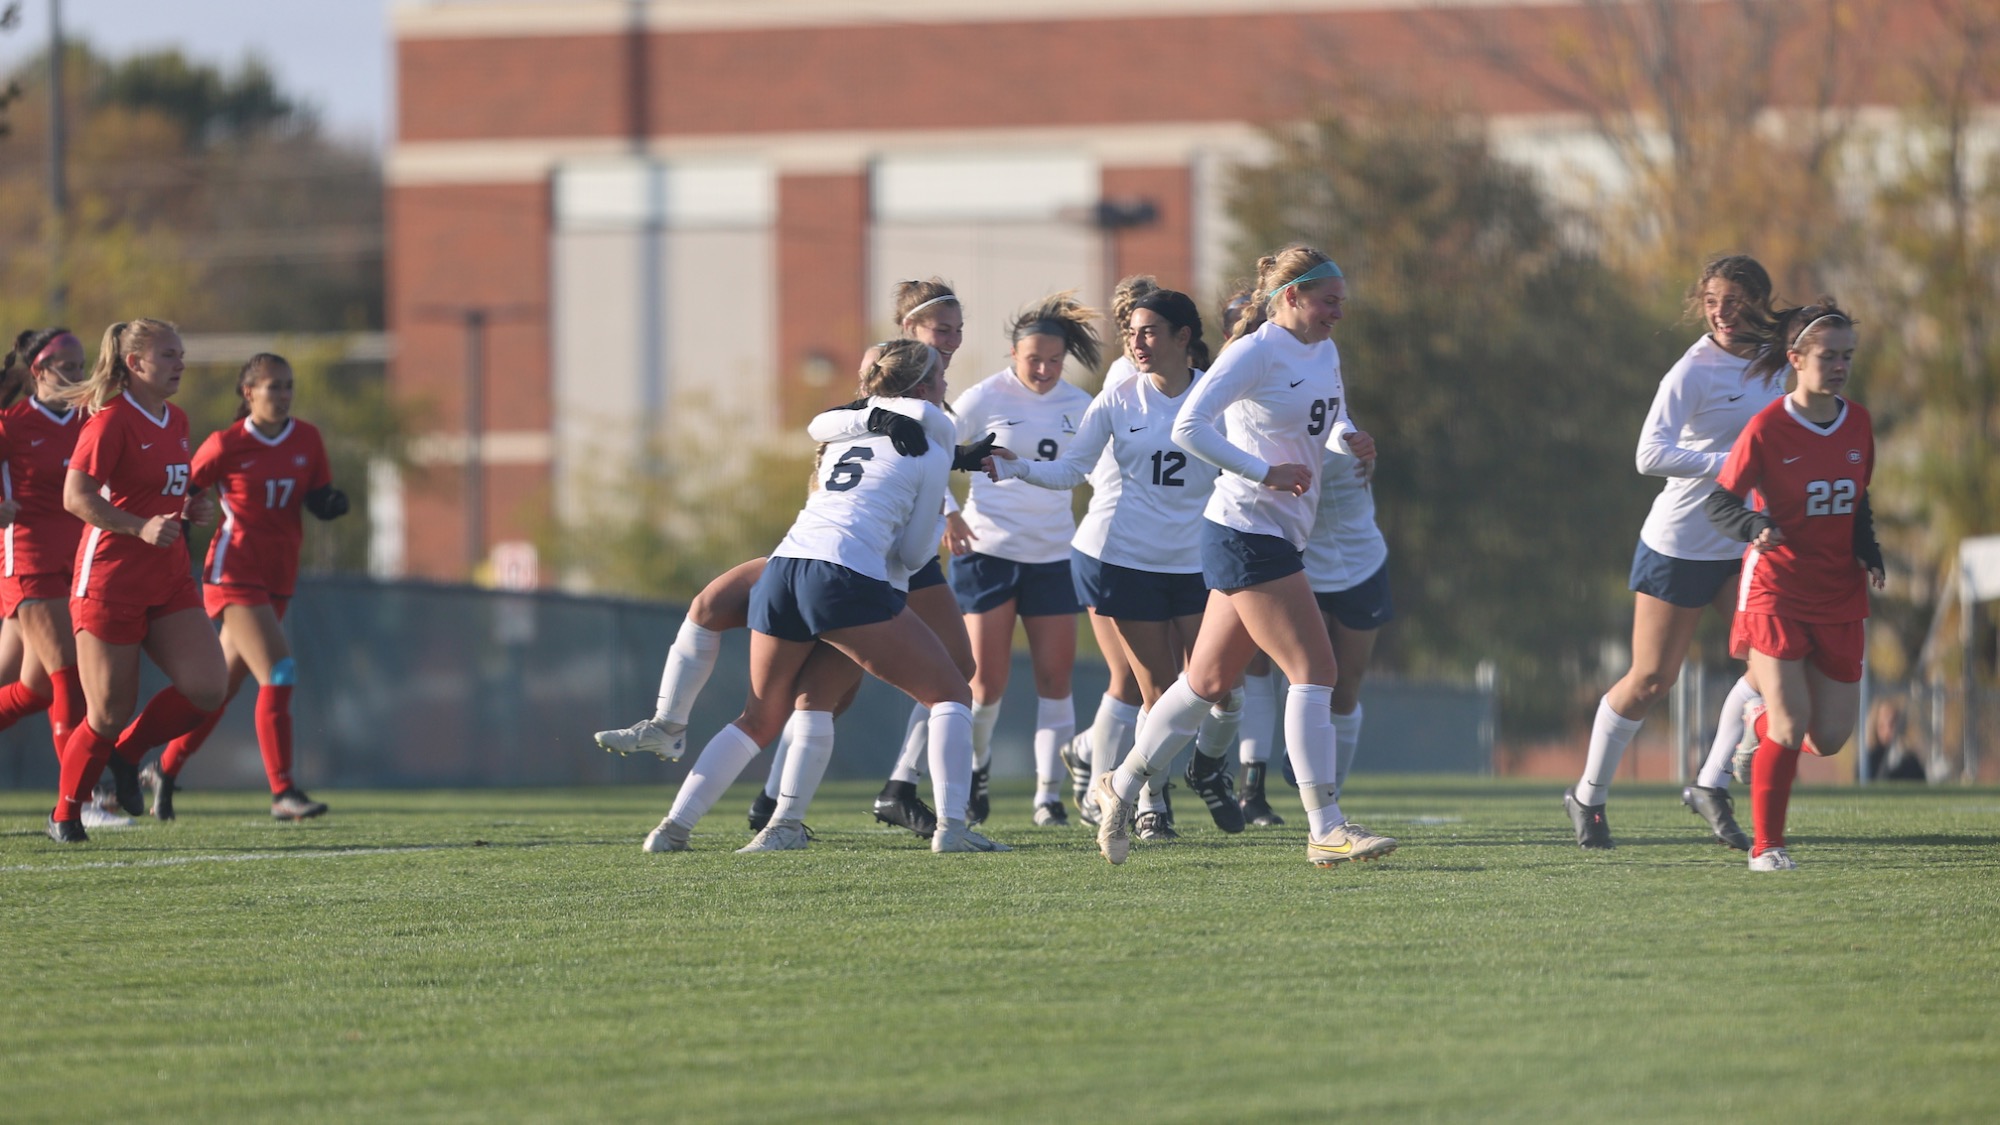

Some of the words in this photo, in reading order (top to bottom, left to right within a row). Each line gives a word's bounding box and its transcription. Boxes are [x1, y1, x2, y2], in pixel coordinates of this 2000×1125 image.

[1307, 397, 1340, 436] 97
[1035, 438, 1058, 461] 9
[161, 463, 189, 496] 15
[825, 446, 875, 492] 6
[1151, 450, 1187, 486] 12
[265, 478, 296, 508] 17
[1805, 478, 1856, 516] 22
